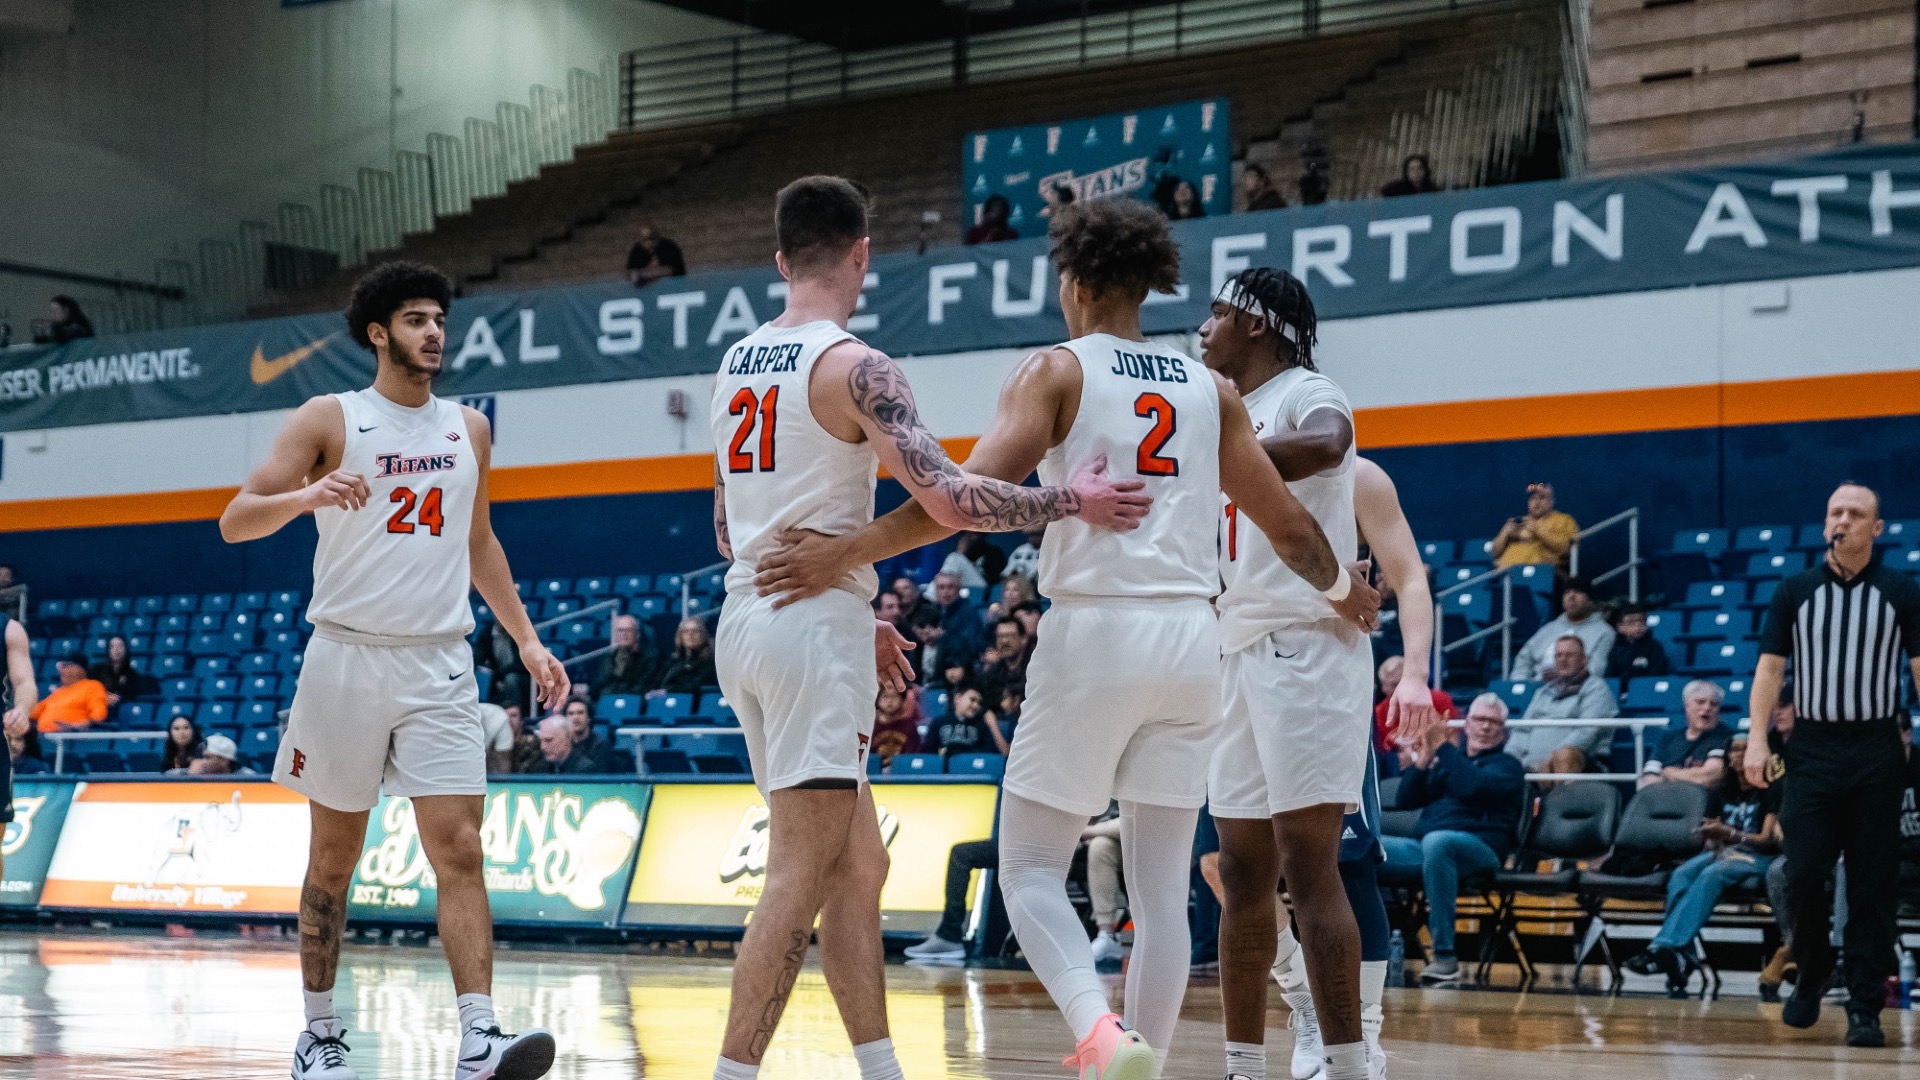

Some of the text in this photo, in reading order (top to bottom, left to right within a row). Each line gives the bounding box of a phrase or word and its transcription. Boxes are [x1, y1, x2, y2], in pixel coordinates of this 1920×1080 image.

[452, 308, 560, 371] AL
[928, 193, 1626, 325] FUERTON
[728, 343, 804, 375] CARPER
[1111, 348, 1189, 384] JONES
[728, 384, 780, 474] 21
[1133, 391, 1179, 477] 2
[386, 486, 444, 537] 24
[289, 747, 306, 778] F
